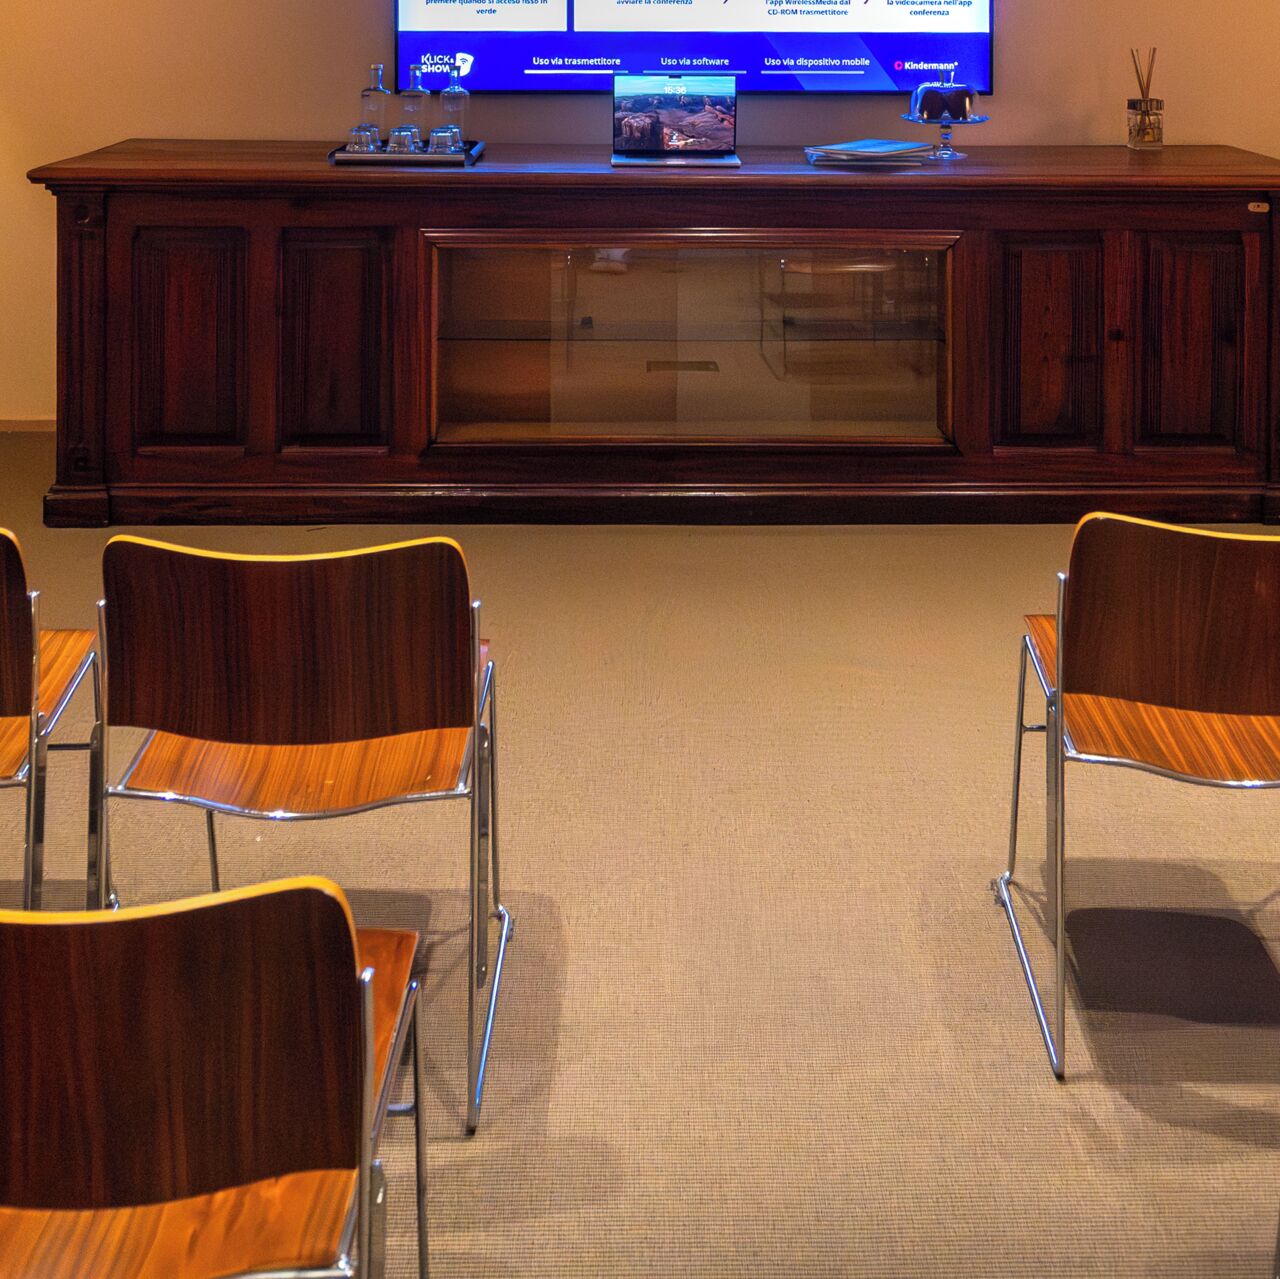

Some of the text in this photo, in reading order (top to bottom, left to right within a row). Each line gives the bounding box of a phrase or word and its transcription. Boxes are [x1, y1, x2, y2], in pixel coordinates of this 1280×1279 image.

[532, 57, 620, 65] Uso via trasmettitore
[660, 57, 729, 65] Uso via software
[764, 57, 870, 67] Uso via dispositivo mobile
